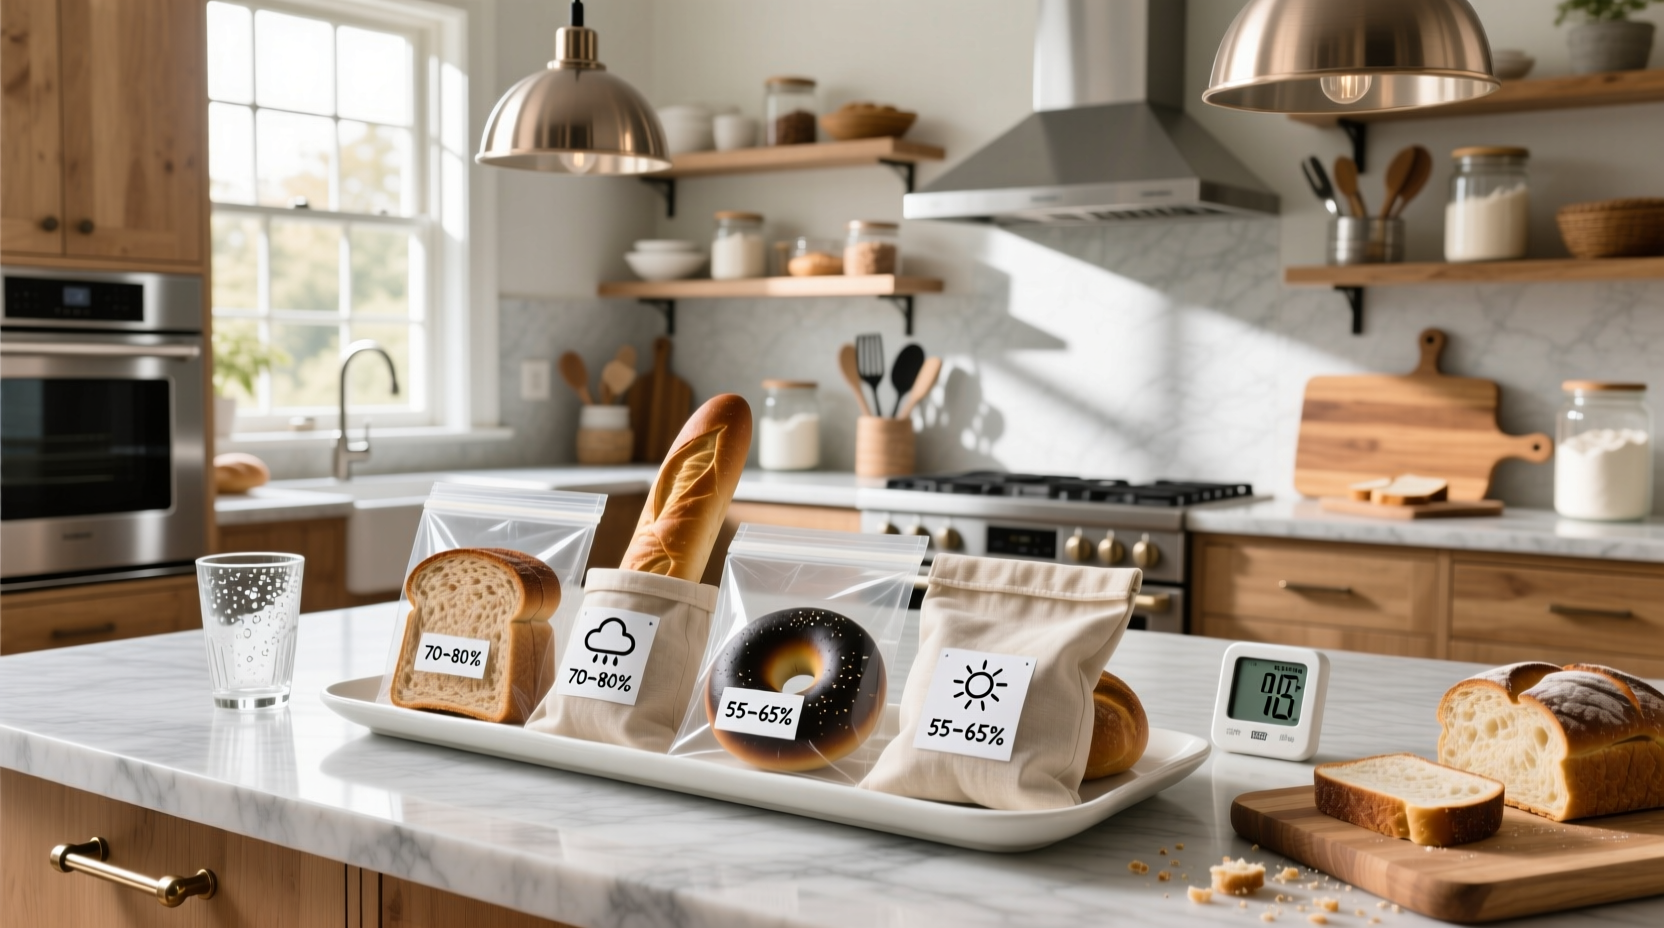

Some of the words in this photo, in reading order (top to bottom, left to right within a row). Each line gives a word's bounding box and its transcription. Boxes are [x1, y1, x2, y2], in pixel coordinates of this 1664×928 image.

[425, 645, 482, 667] 70-80%
[568, 668, 632, 692] 70-80%
[725, 701, 793, 726] 55-65%
[927, 718, 1005, 746] 55-65%
